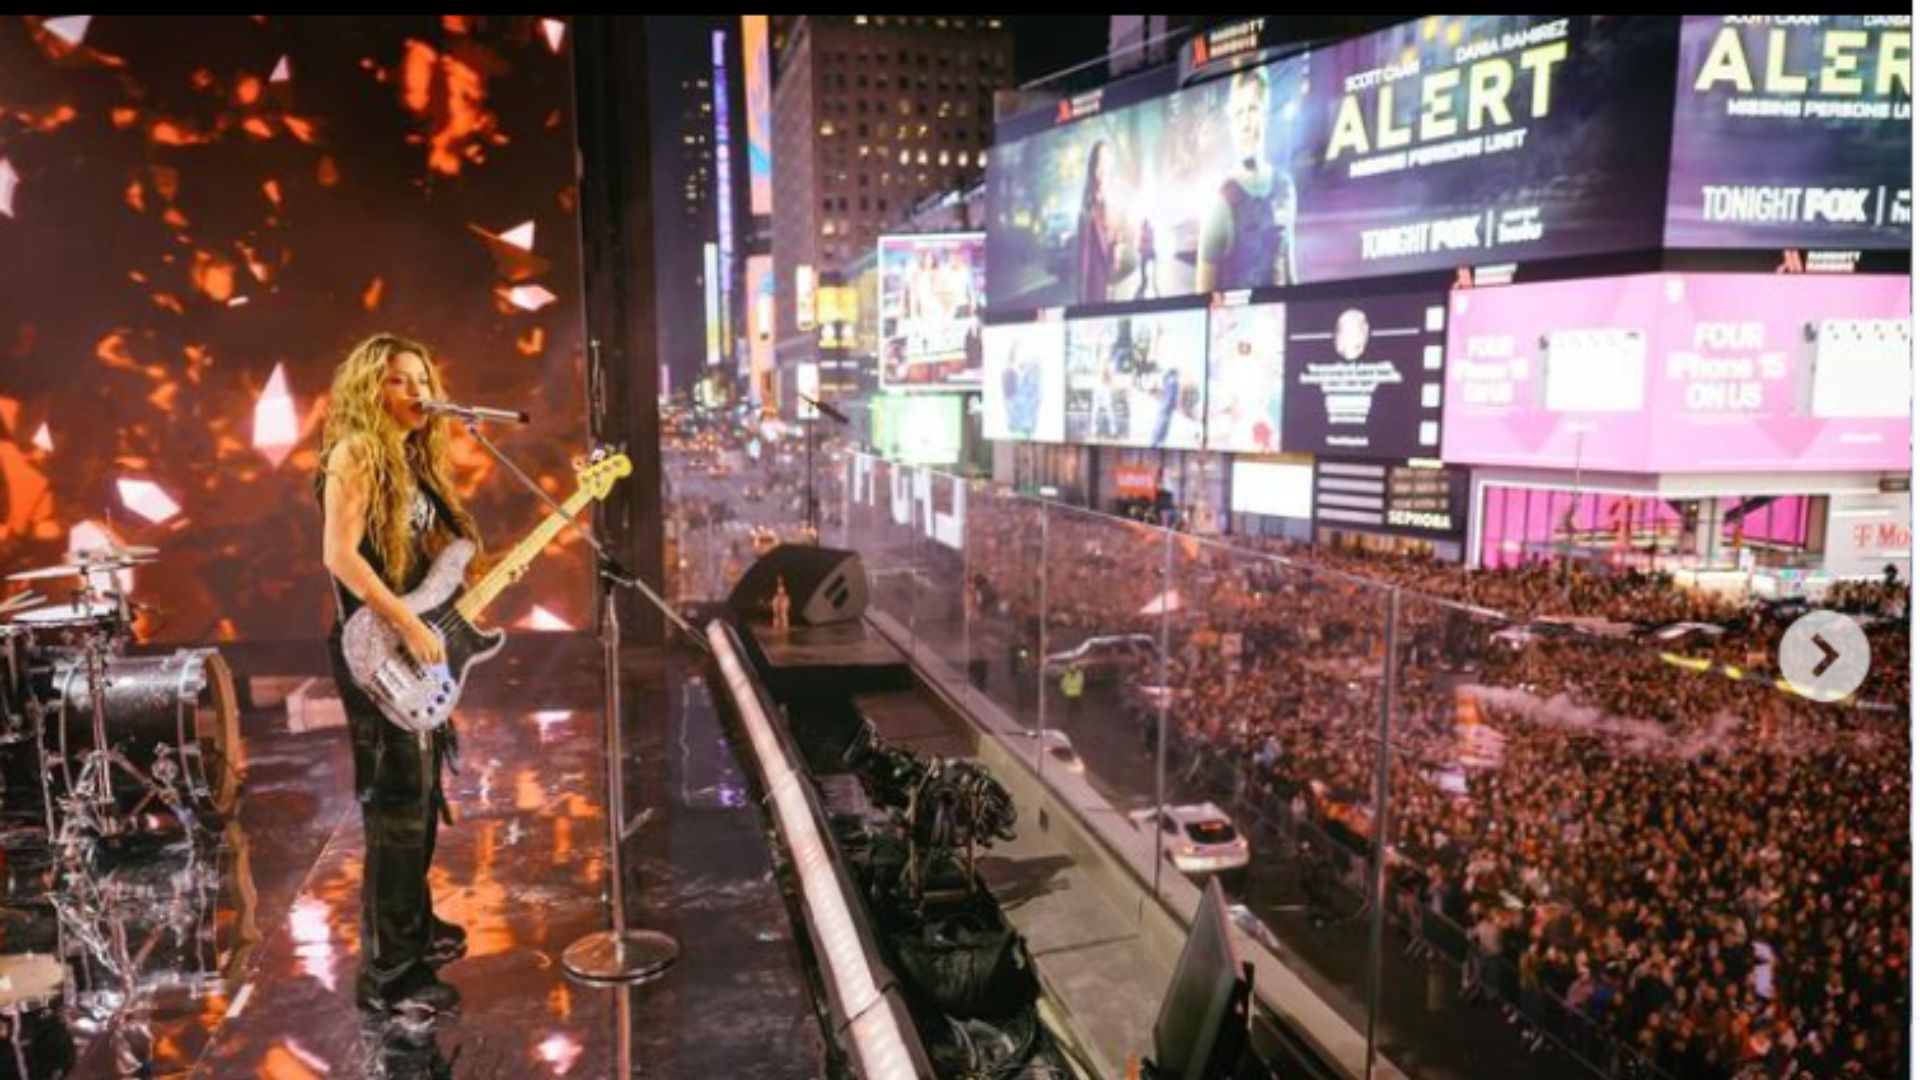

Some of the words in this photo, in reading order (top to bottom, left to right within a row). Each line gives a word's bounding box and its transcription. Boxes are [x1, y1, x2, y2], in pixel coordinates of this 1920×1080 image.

[1325, 42, 1568, 161] ALERT
[1702, 185, 1801, 222] TONIGHT
[1803, 188, 1869, 222] FOX
[1694, 322, 1765, 350] FOUR
[1686, 383, 1725, 409] ON
[1727, 382, 1763, 409] US
[1387, 510, 1451, 529] SEPHORA
